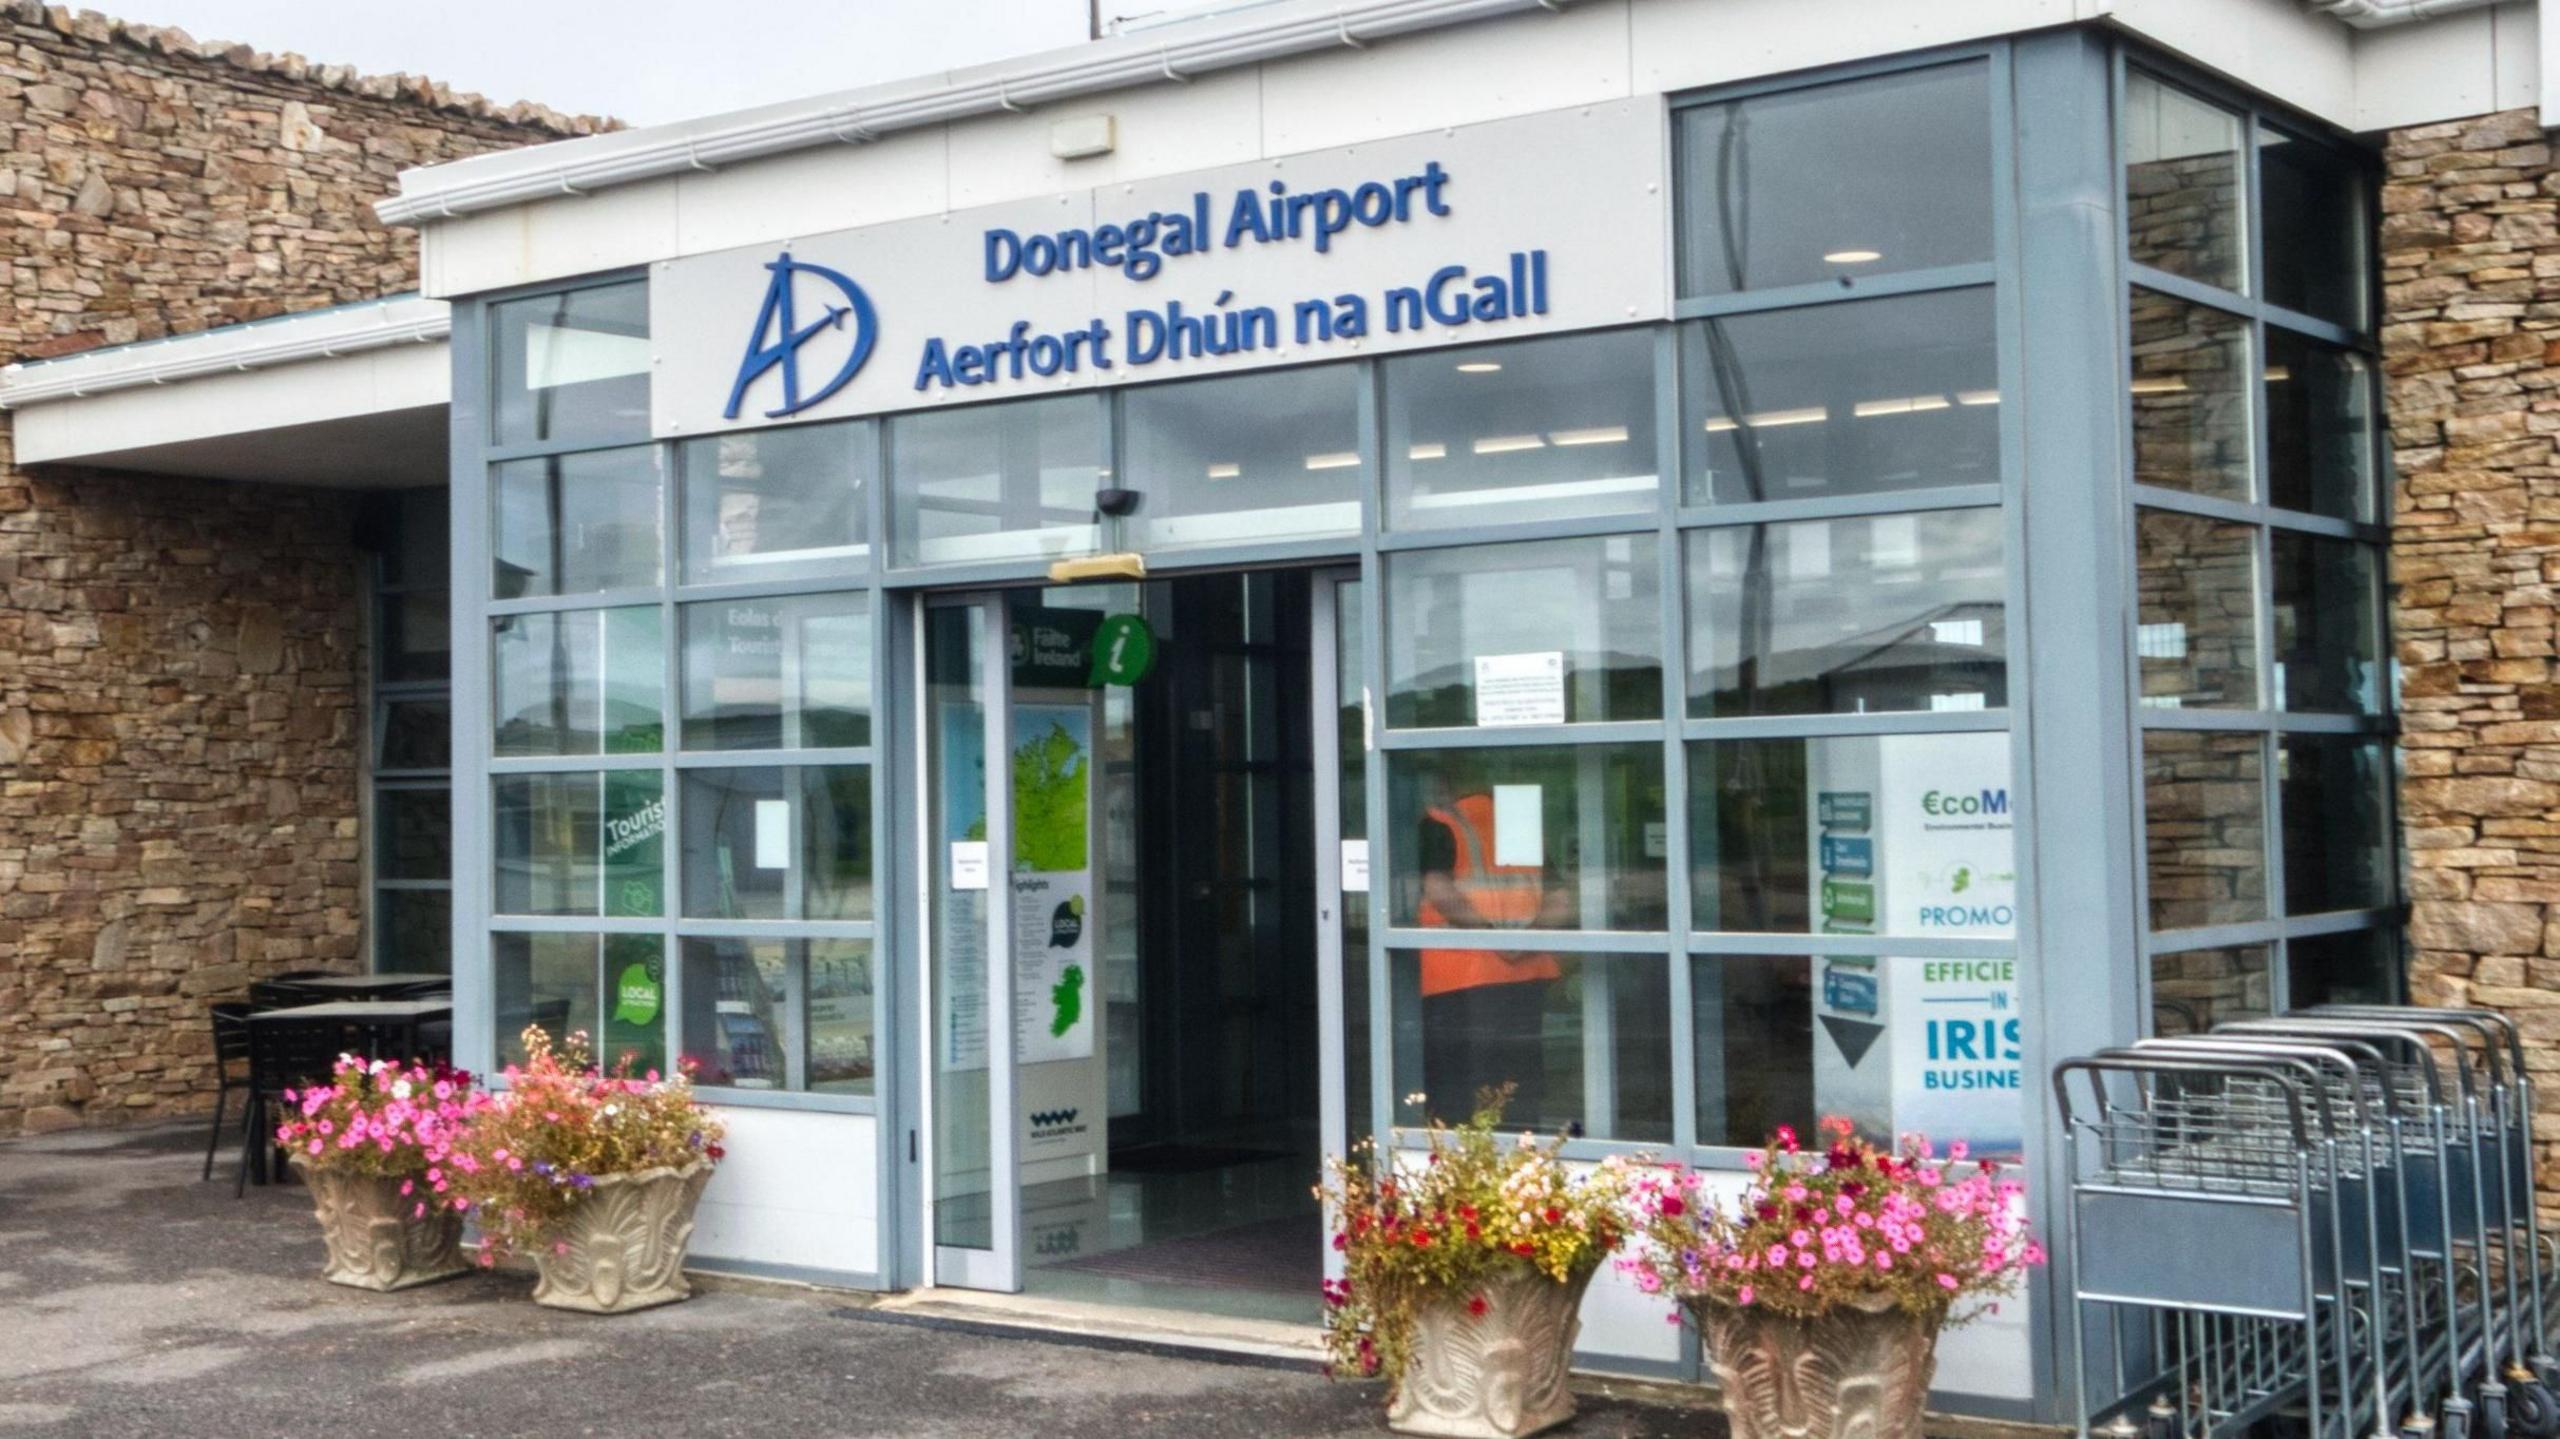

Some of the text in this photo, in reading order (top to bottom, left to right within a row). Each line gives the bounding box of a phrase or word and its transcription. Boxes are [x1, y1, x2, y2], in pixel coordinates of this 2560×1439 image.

[984, 161, 1450, 281] Donegal Airport
[914, 249, 1548, 391] Aerfort Dhún na nGall
[1033, 648, 1081, 667] Ireland
[1922, 789, 2012, 815] €coM
[1920, 905, 2013, 926] PROMO
[1924, 961, 2014, 982] EFFICIE
[621, 986, 656, 999] LOCAL
[1991, 991, 2007, 1010] IN
[1924, 1070, 2021, 1089] BUSINE
